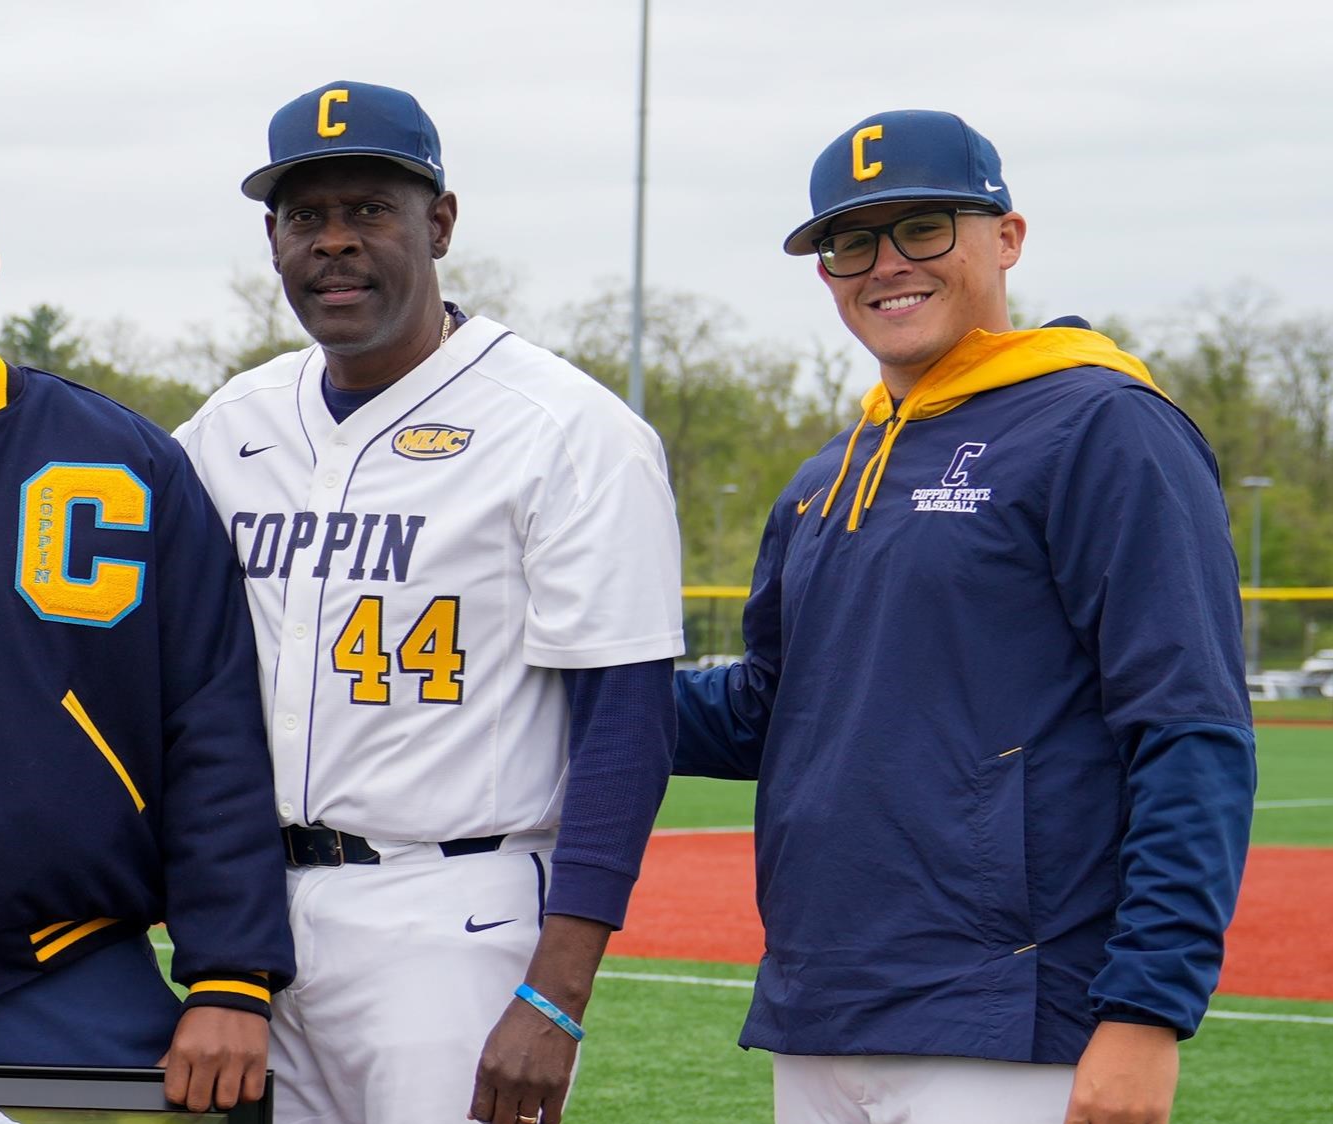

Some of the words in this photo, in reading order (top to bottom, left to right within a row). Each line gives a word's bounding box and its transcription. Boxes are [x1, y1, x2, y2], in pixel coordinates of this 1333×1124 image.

[316, 89, 349, 138] C
[852, 125, 883, 181] C
[941, 442, 987, 487] C
[911, 488, 953, 501] COPPIN
[953, 488, 991, 501] STATE
[914, 500, 978, 513] BASEBALL
[14, 461, 152, 629] C
[34, 487, 54, 584] COPPIN
[231, 511, 426, 583] COPPIN
[331, 596, 465, 705] 44
